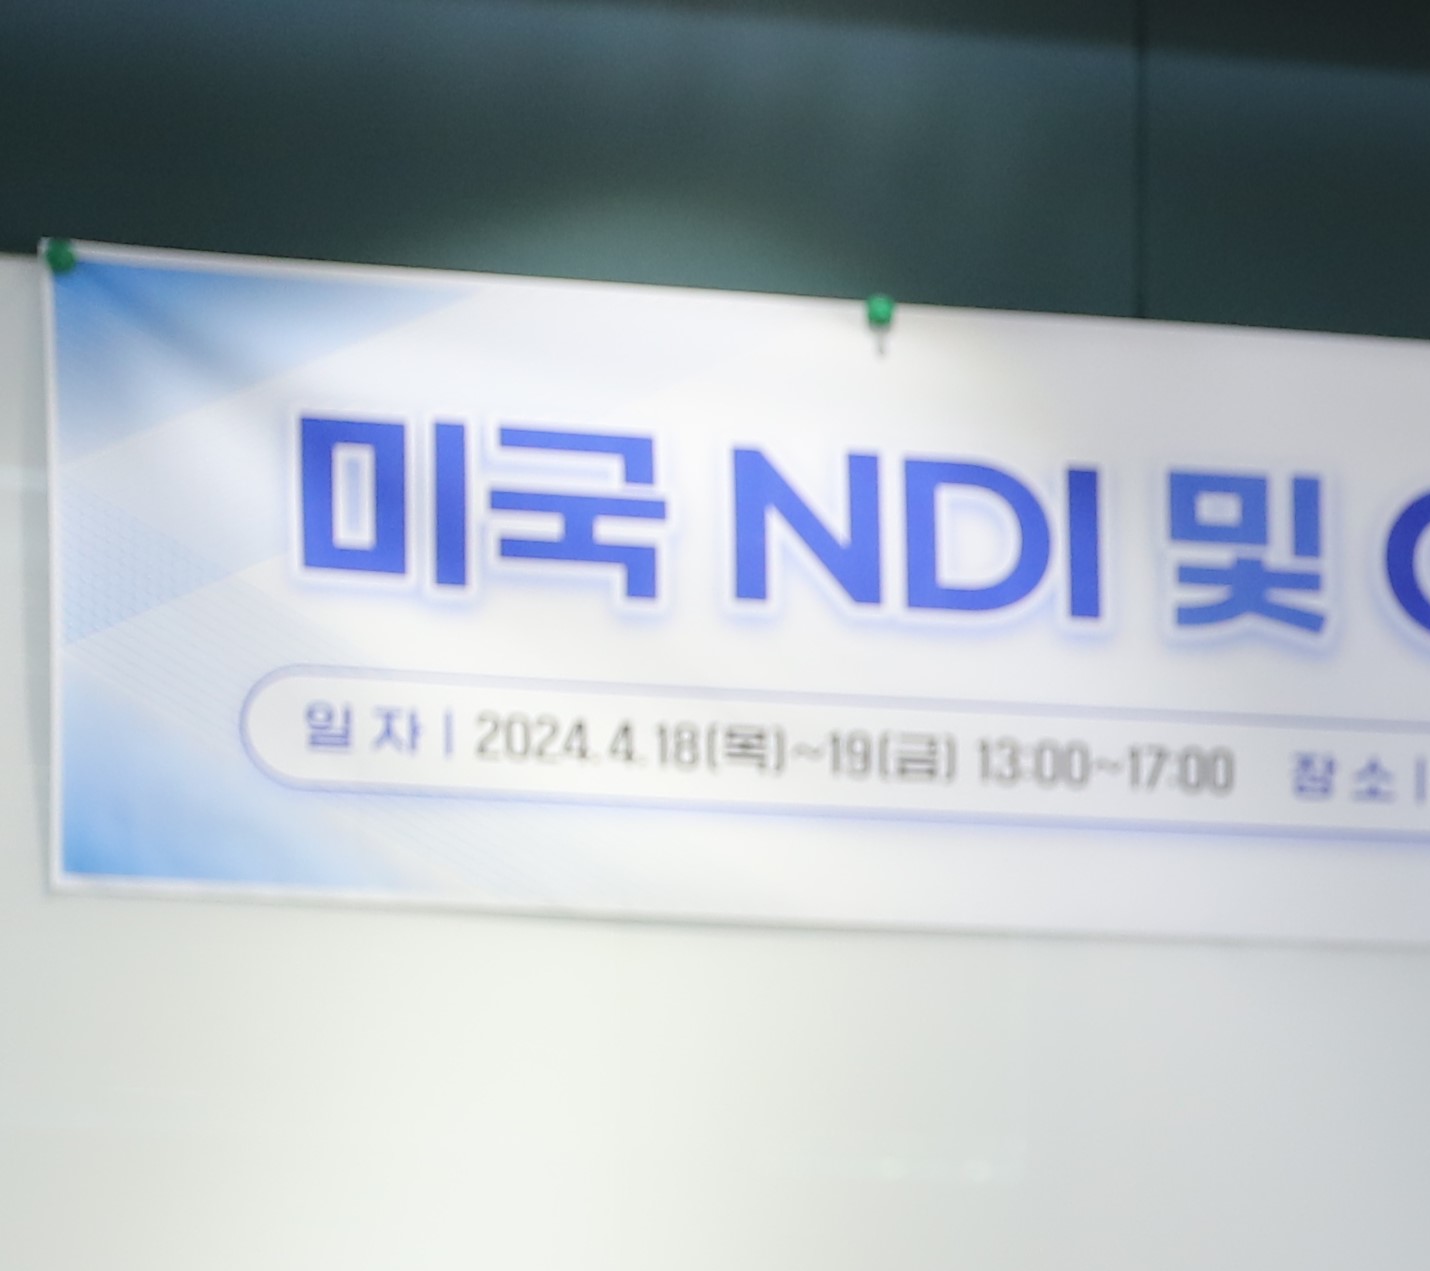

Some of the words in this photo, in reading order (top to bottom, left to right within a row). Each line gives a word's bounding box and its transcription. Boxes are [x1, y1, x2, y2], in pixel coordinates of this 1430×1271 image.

[299, 414, 667, 601] 미국
[732, 447, 1102, 621] NDI
[1167, 470, 1327, 634] 및
[978, 737, 1236, 797] 13:00~17:00
